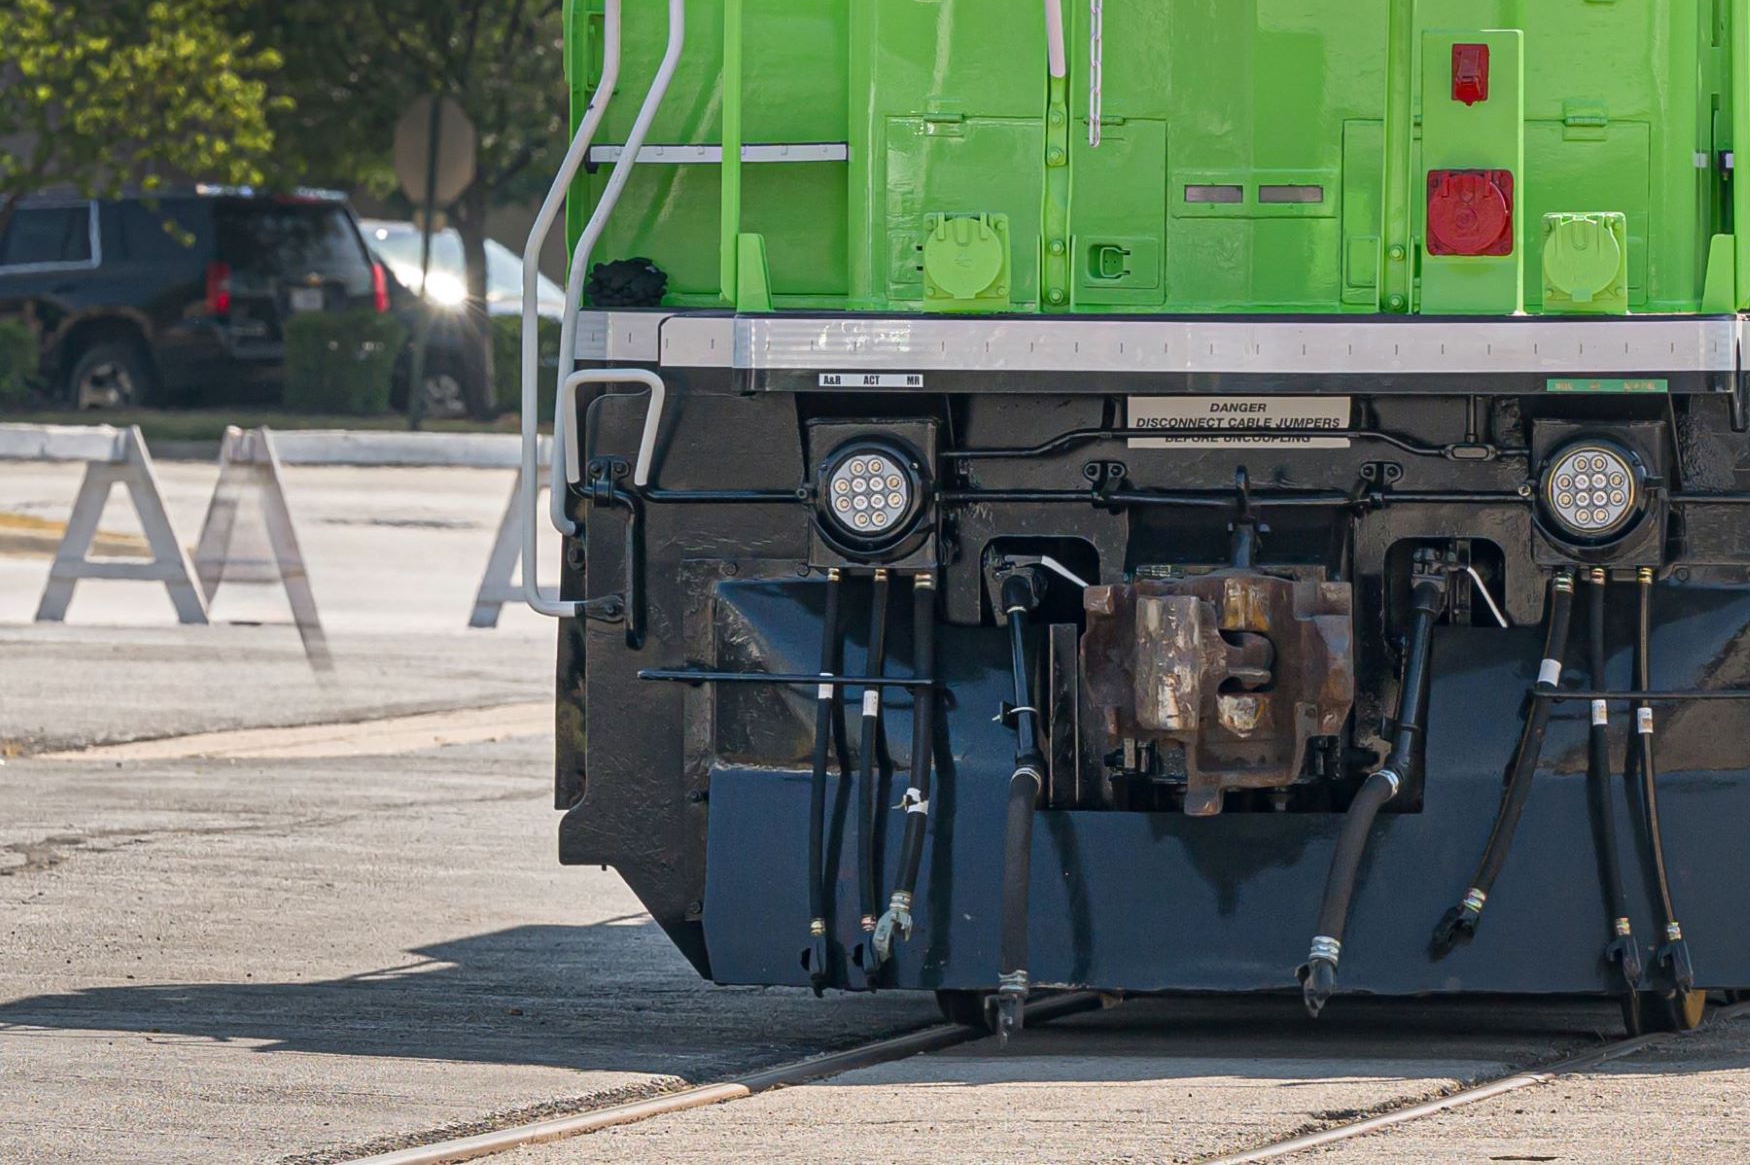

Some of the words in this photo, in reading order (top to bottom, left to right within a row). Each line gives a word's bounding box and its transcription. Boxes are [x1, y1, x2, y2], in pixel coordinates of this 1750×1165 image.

[863, 375, 880, 385] ACT
[906, 375, 920, 386] MR
[1209, 403, 1267, 413] DANGER
[1136, 417, 1224, 428] DISCONNECT
[1228, 417, 1272, 428] CABLE
[1275, 417, 1341, 428] JUMPERS
